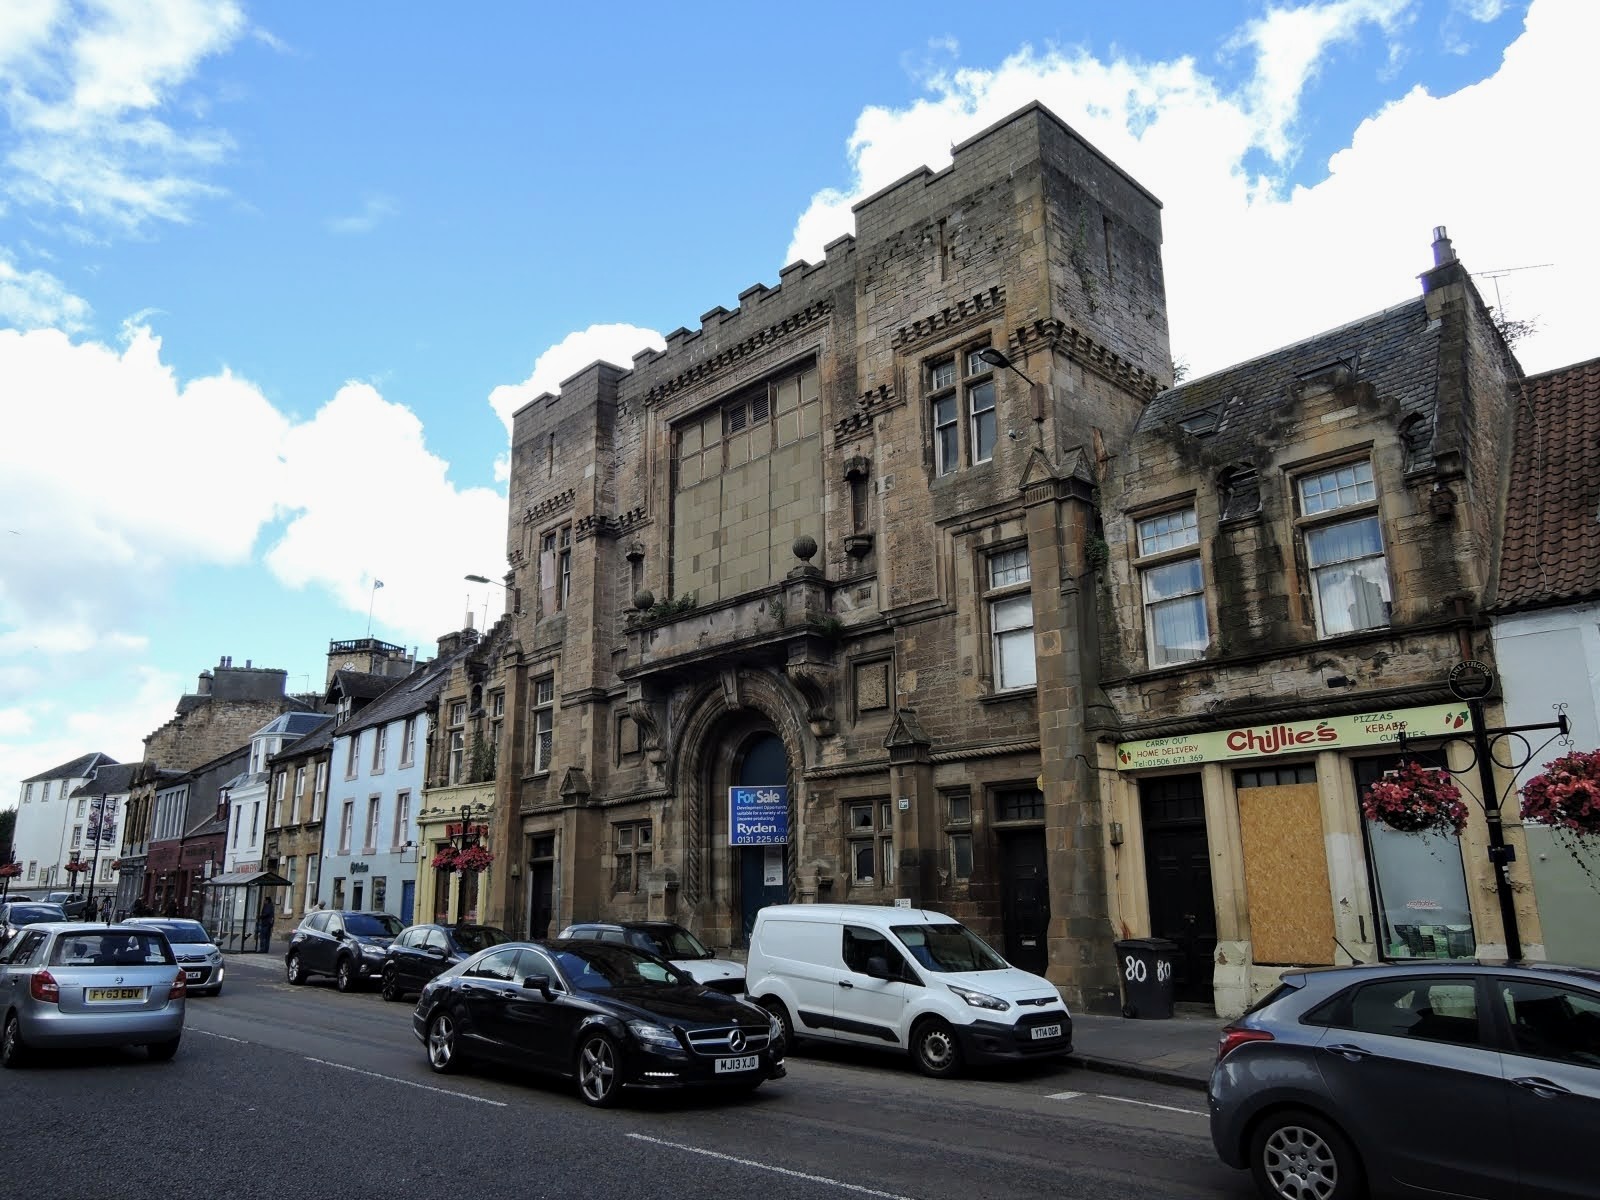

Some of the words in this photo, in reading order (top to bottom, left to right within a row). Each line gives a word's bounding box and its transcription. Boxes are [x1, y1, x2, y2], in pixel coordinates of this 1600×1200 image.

[1451, 661, 1491, 681] LINLITHGOW
[1353, 712, 1393, 723] PIZZAS
[1365, 721, 1406, 734] KEBABS
[1145, 739, 1169, 748] CARRY
[1172, 736, 1189, 745] OUT
[1379, 730, 1427, 742] CURIES
[1136, 749, 1159, 758] HOME
[1162, 744, 1199, 756] DELIVERY
[1134, 757, 1170, 768] Tel:01506
[1173, 756, 1186, 764] 671
[1189, 754, 1204, 763] 369
[737, 790, 755, 804] For
[756, 789, 780, 804] Sale
[737, 836, 754, 844] 0131
[756, 835, 772, 843] 225
[774, 835, 788, 843] 661
[1125, 955, 1147, 983] 80
[1157, 959, 1171, 982] 80
[720, 1059, 741, 1071] MJ13
[742, 1057, 756, 1069] XJD
